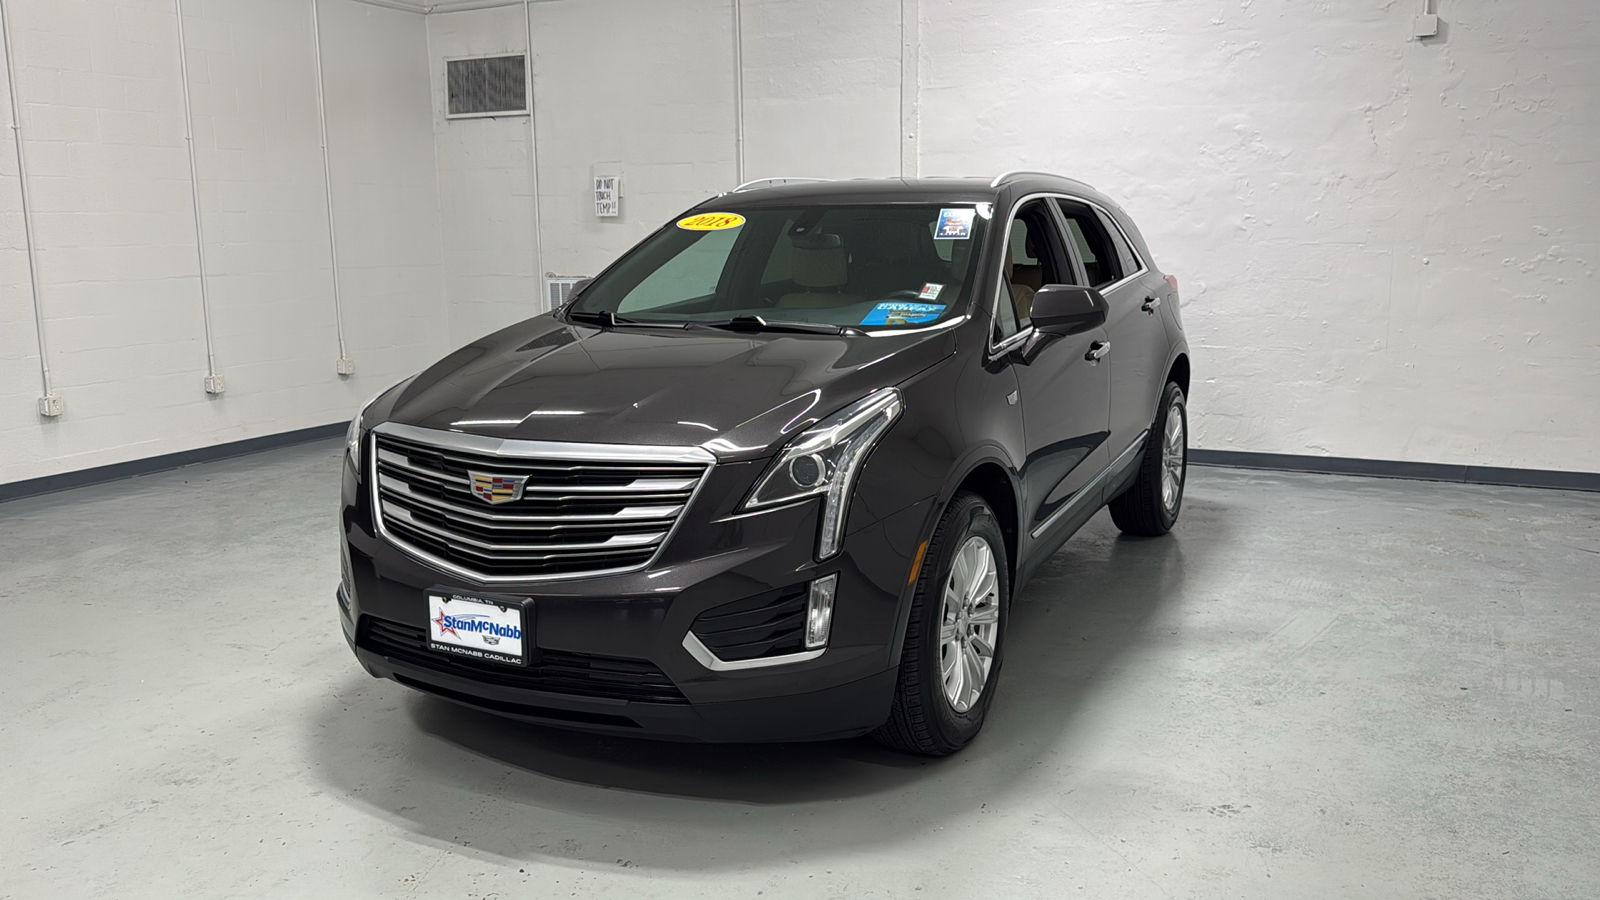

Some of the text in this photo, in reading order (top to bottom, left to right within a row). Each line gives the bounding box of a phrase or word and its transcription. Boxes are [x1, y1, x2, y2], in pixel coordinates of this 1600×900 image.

[596, 179, 614, 190] DO NOT
[683, 216, 738, 227] 2018
[443, 615, 521, 639] StanMcNabb
[430, 643, 522, 664] STAN MCNABB CADILLAC
